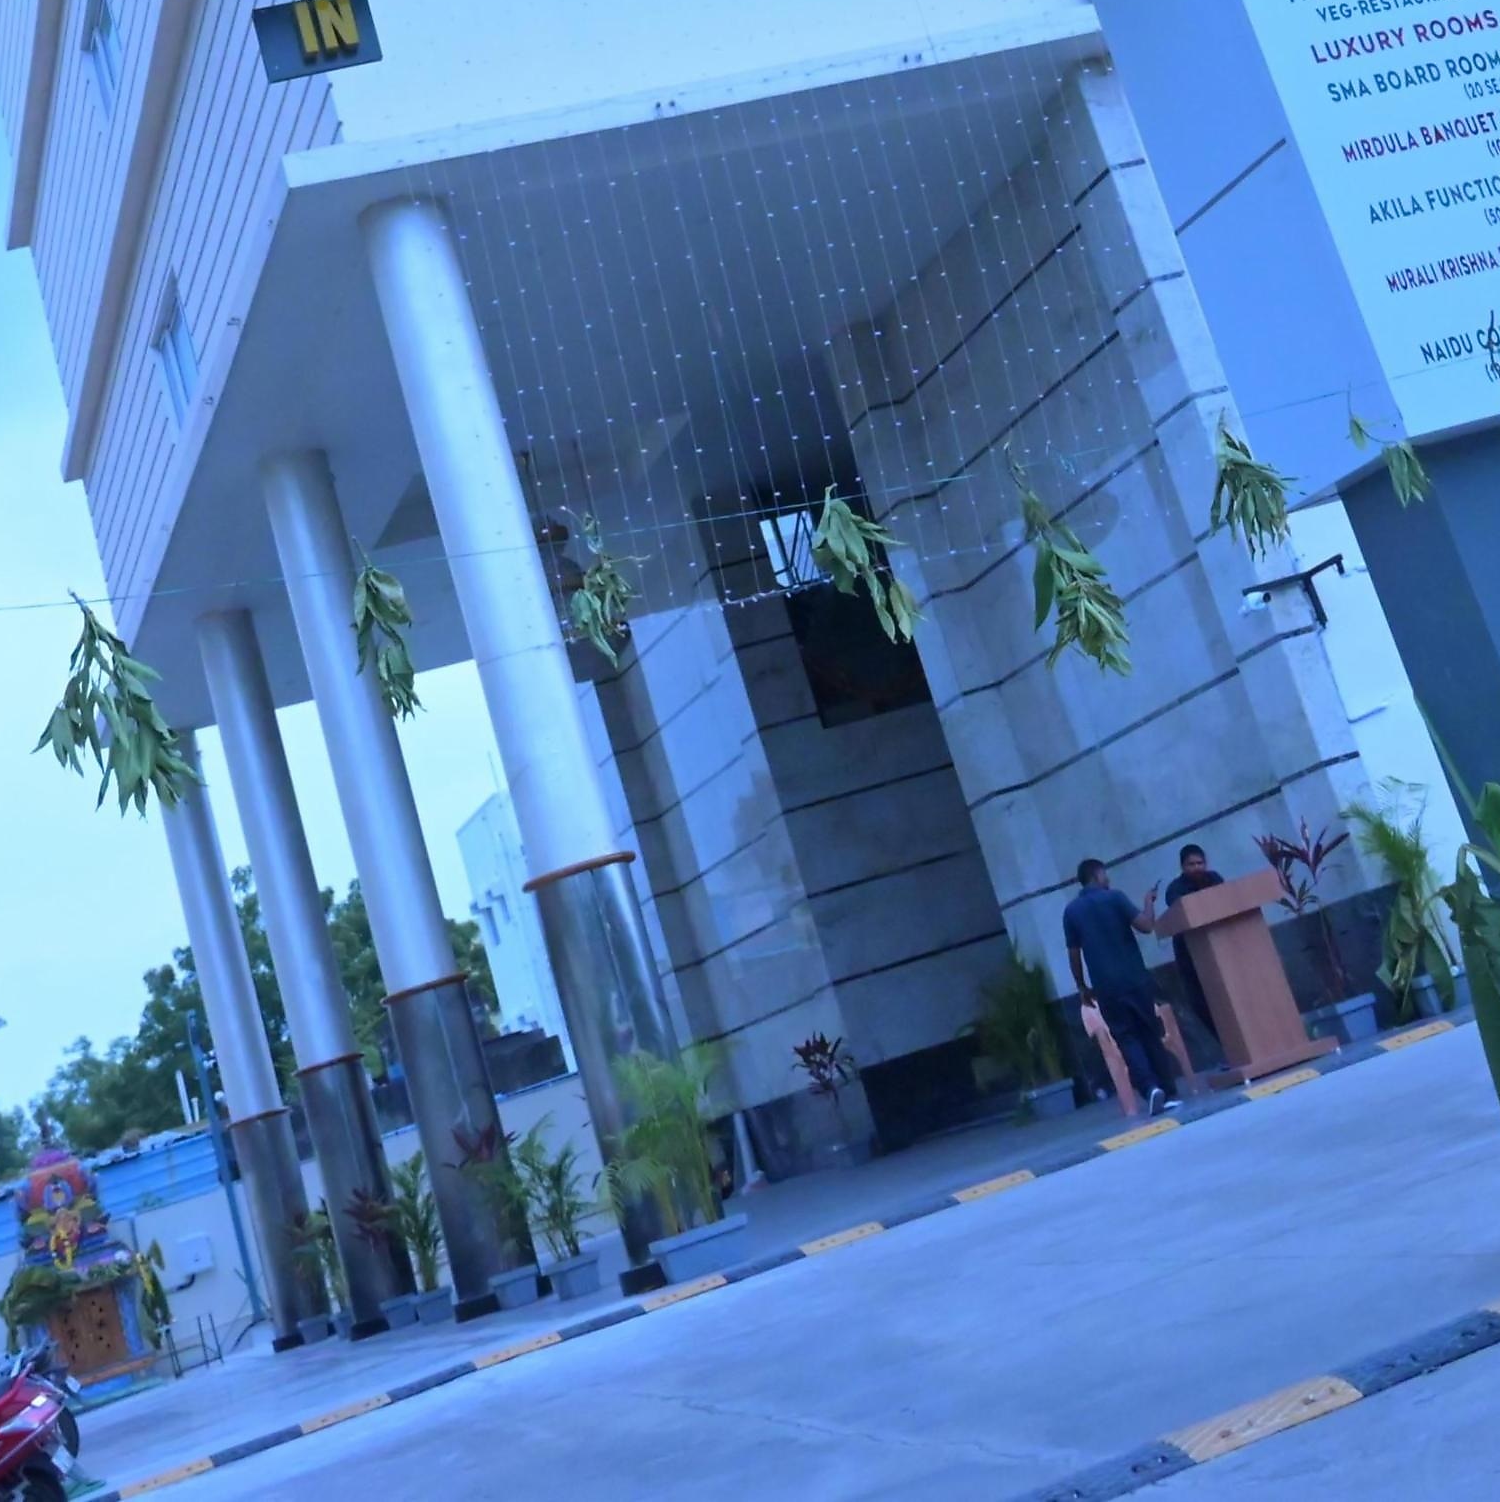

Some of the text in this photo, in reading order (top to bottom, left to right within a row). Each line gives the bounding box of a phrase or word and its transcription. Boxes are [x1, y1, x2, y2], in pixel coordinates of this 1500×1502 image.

[1310, 9, 1499, 64] LUXURY ROOMS
[1327, 78, 1372, 103] SMA
[1373, 62, 1441, 94] BOARD
[1463, 80, 1484, 100] (20
[1341, 130, 1419, 163] MIRDULA
[1420, 111, 1498, 146] BANQUET
[1368, 195, 1424, 224] AKILA
[1385, 263, 1439, 293] MURALI
[1438, 251, 1500, 281] KRISHNA
[1420, 332, 1474, 365] NAIDU
